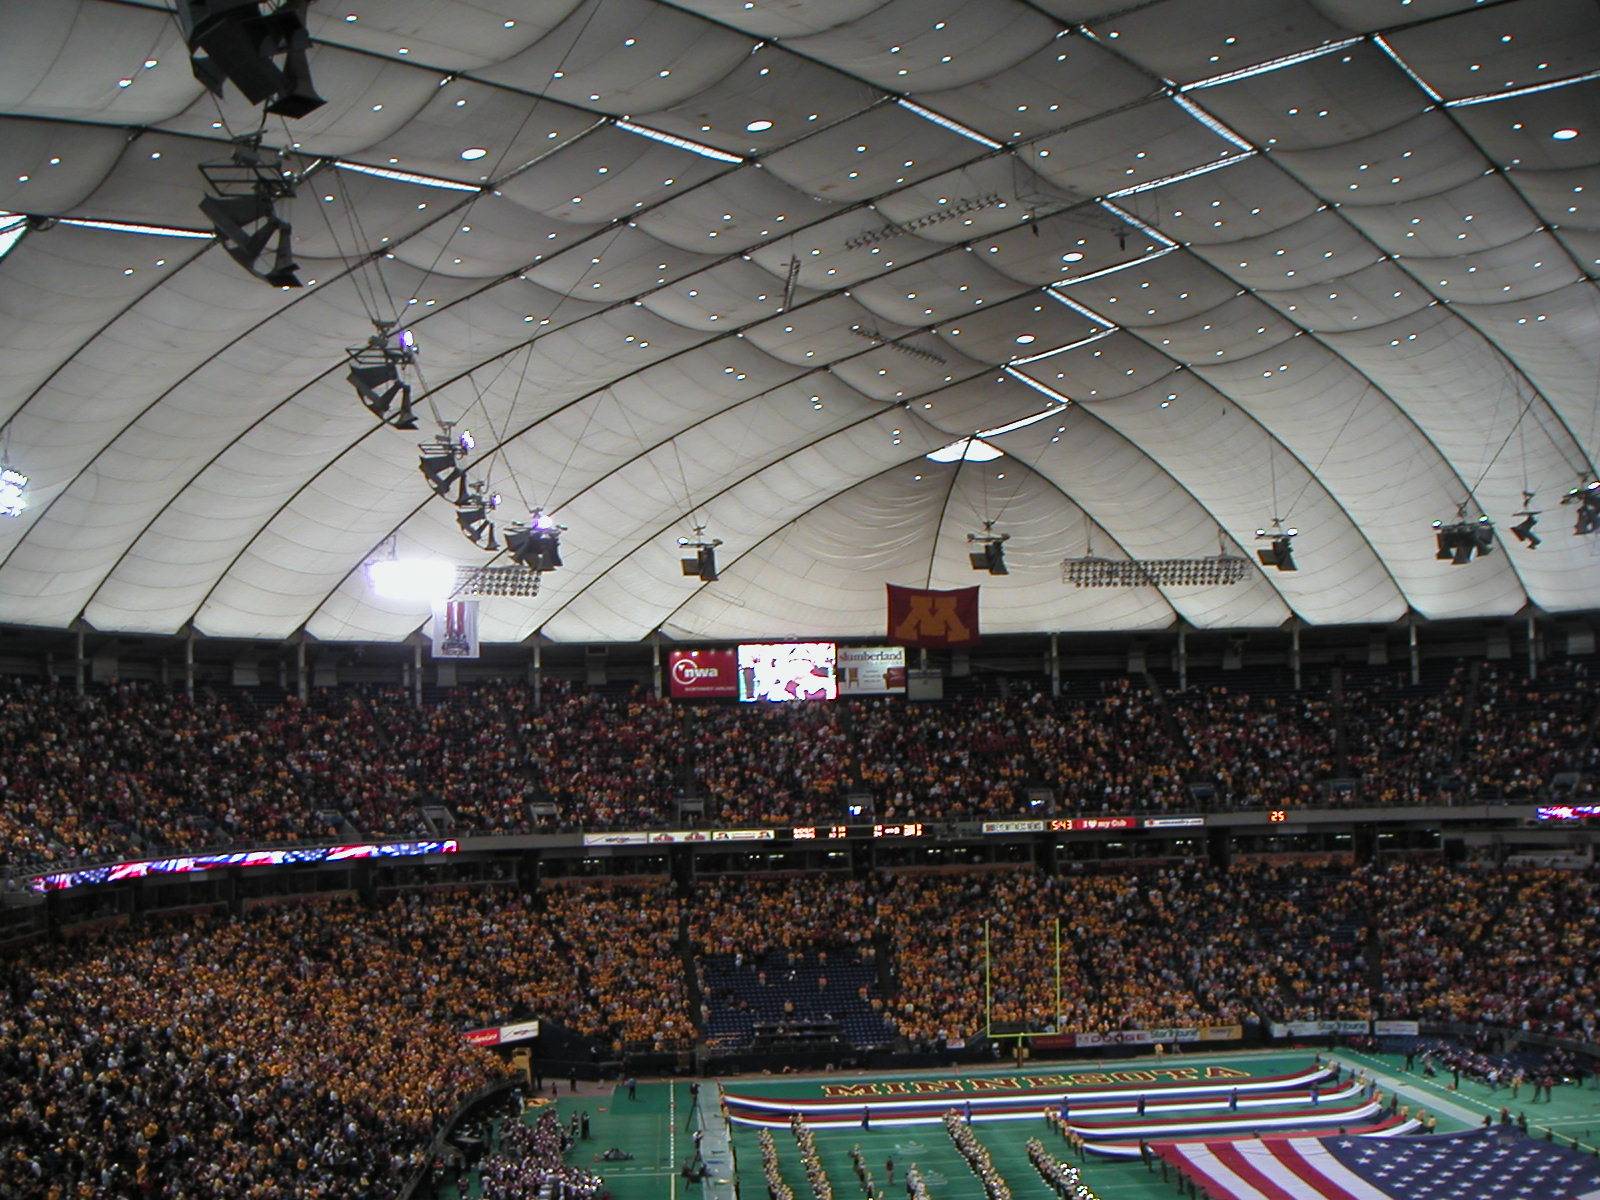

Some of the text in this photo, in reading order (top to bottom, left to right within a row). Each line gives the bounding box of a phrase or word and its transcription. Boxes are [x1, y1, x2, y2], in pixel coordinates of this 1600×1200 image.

[684, 668, 718, 678] nwa
[1271, 811, 1285, 822] 25
[1098, 820, 1110, 830] my
[1111, 818, 1126, 828] Cub
[821, 1066, 1251, 1098] MINNESOTA
